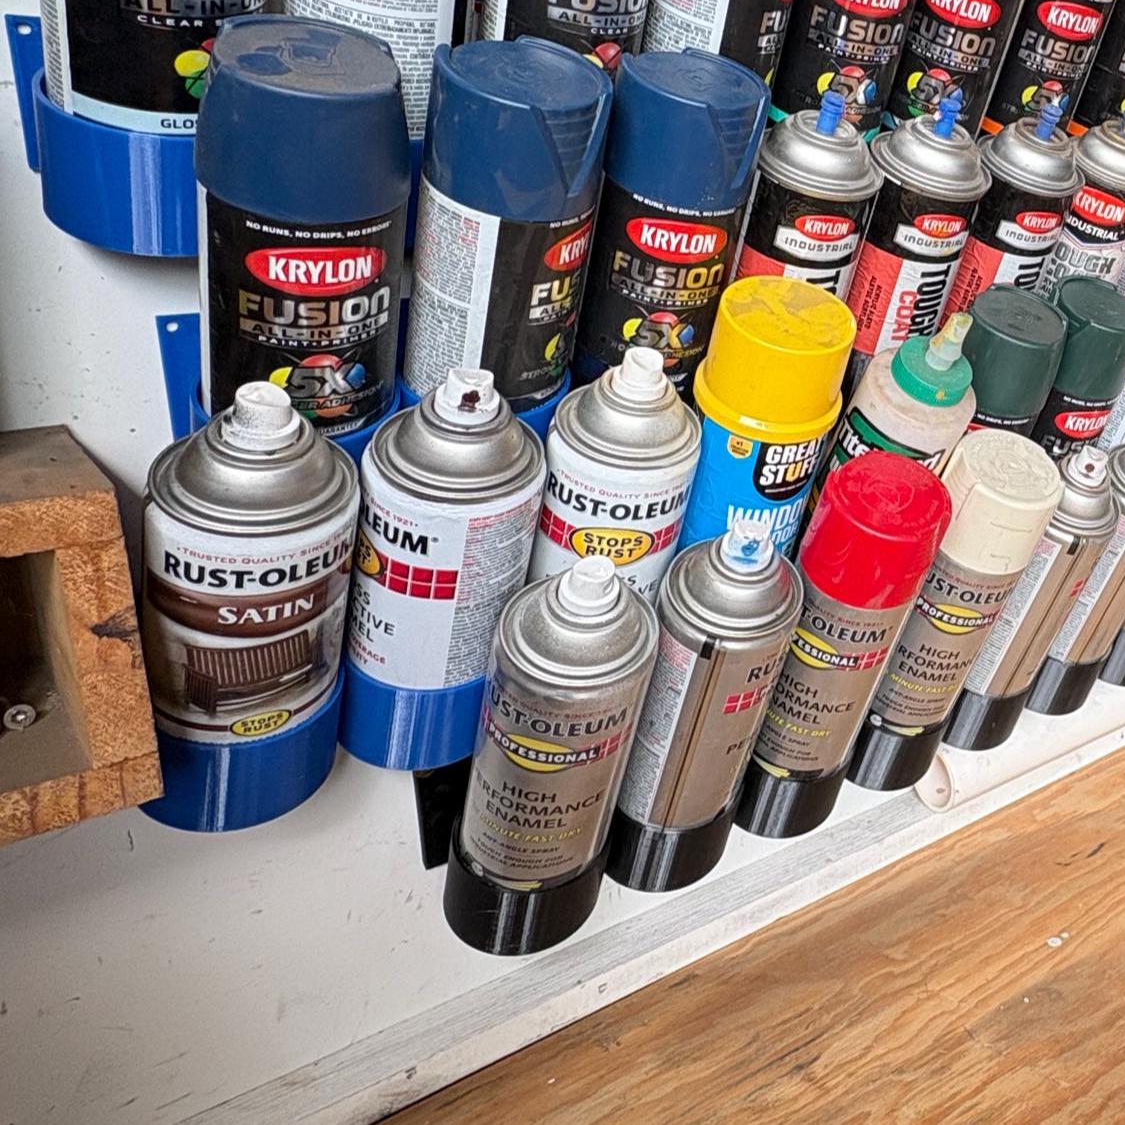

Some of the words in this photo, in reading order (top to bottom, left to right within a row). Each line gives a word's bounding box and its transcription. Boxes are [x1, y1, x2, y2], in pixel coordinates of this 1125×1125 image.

[137, 14, 203, 28] CLEAR
[810, 5, 904, 44] FUSION
[1047, 6, 1099, 34] KRYLON
[246, 220, 260, 230] NO
[262, 225, 292, 238] RUNS,
[295, 231, 310, 239] NO
[312, 231, 345, 239] DRIPS,
[347, 230, 360, 238] NO
[804, 220, 849, 235] KRYLON
[921, 218, 963, 233] KRYLON
[1023, 215, 1057, 228] KRYLON
[640, 224, 717, 254] KRYLON
[785, 237, 853, 252] INDUSTRIAL
[904, 234, 963, 249] INDUSTRIAL
[1055, 241, 1116, 274] OUGH
[268, 255, 372, 284] KRYLON
[613, 250, 724, 289] FUSION
[620, 278, 716, 299] ALL-IN-ONE
[238, 286, 390, 326] FUSION
[251, 318, 381, 339] ALL-IN-ONE
[759, 455, 818, 486] STUFF
[559, 469, 596, 493] TRUSTED
[598, 488, 641, 500] QUALITY
[549, 472, 689, 522] RUST-OLEUM
[583, 532, 643, 547] STOPS
[585, 544, 637, 558] RUST
[164, 537, 351, 589] RUST-OLEUM
[182, 547, 237, 565] TRUSTED
[242, 553, 296, 565] QUALITY
[300, 542, 331, 556] SINCE
[218, 594, 315, 625] SATIN
[917, 597, 993, 627] PROFESSIONAL
[919, 644, 960, 660] HIGH
[898, 661, 957, 682] ENAMEL
[779, 673, 818, 698] HIGH
[241, 713, 283, 725] STOPS
[243, 720, 279, 733] RUST
[488, 721, 600, 763] PROFESSIONAL
[502, 781, 557, 803] HIGH
[486, 801, 567, 829] ENAMEL
